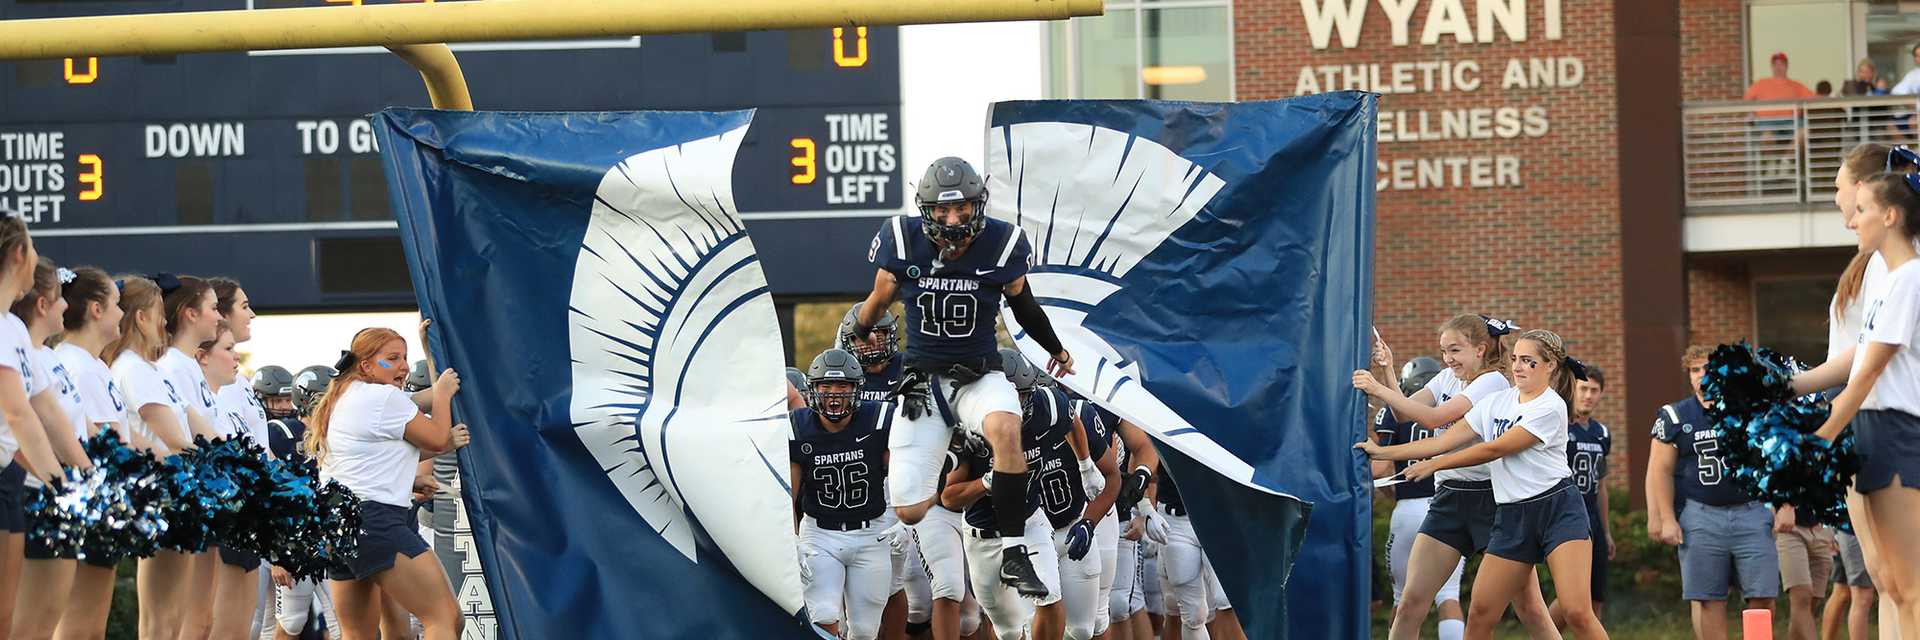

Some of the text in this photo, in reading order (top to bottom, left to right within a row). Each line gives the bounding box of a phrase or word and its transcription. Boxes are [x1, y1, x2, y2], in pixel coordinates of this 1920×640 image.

[1301, 0, 1564, 49] WYANT
[1295, 56, 1584, 97] ATHLETIC AND
[146, 123, 244, 158] DOWN
[296, 119, 380, 154] TO G
[825, 114, 888, 141] TIME
[1377, 107, 1549, 142] ELLNESS
[1, 132, 65, 161] TIME
[791, 138, 816, 184] 3
[825, 144, 896, 173] OUTS
[78, 154, 103, 201] 3
[826, 175, 889, 204] LEFT
[918, 277, 980, 291] SPARTANS
[916, 291, 978, 338] 19
[1694, 429, 1720, 441] SPAR
[814, 449, 864, 466] SPARTANS
[813, 461, 869, 509] 36
